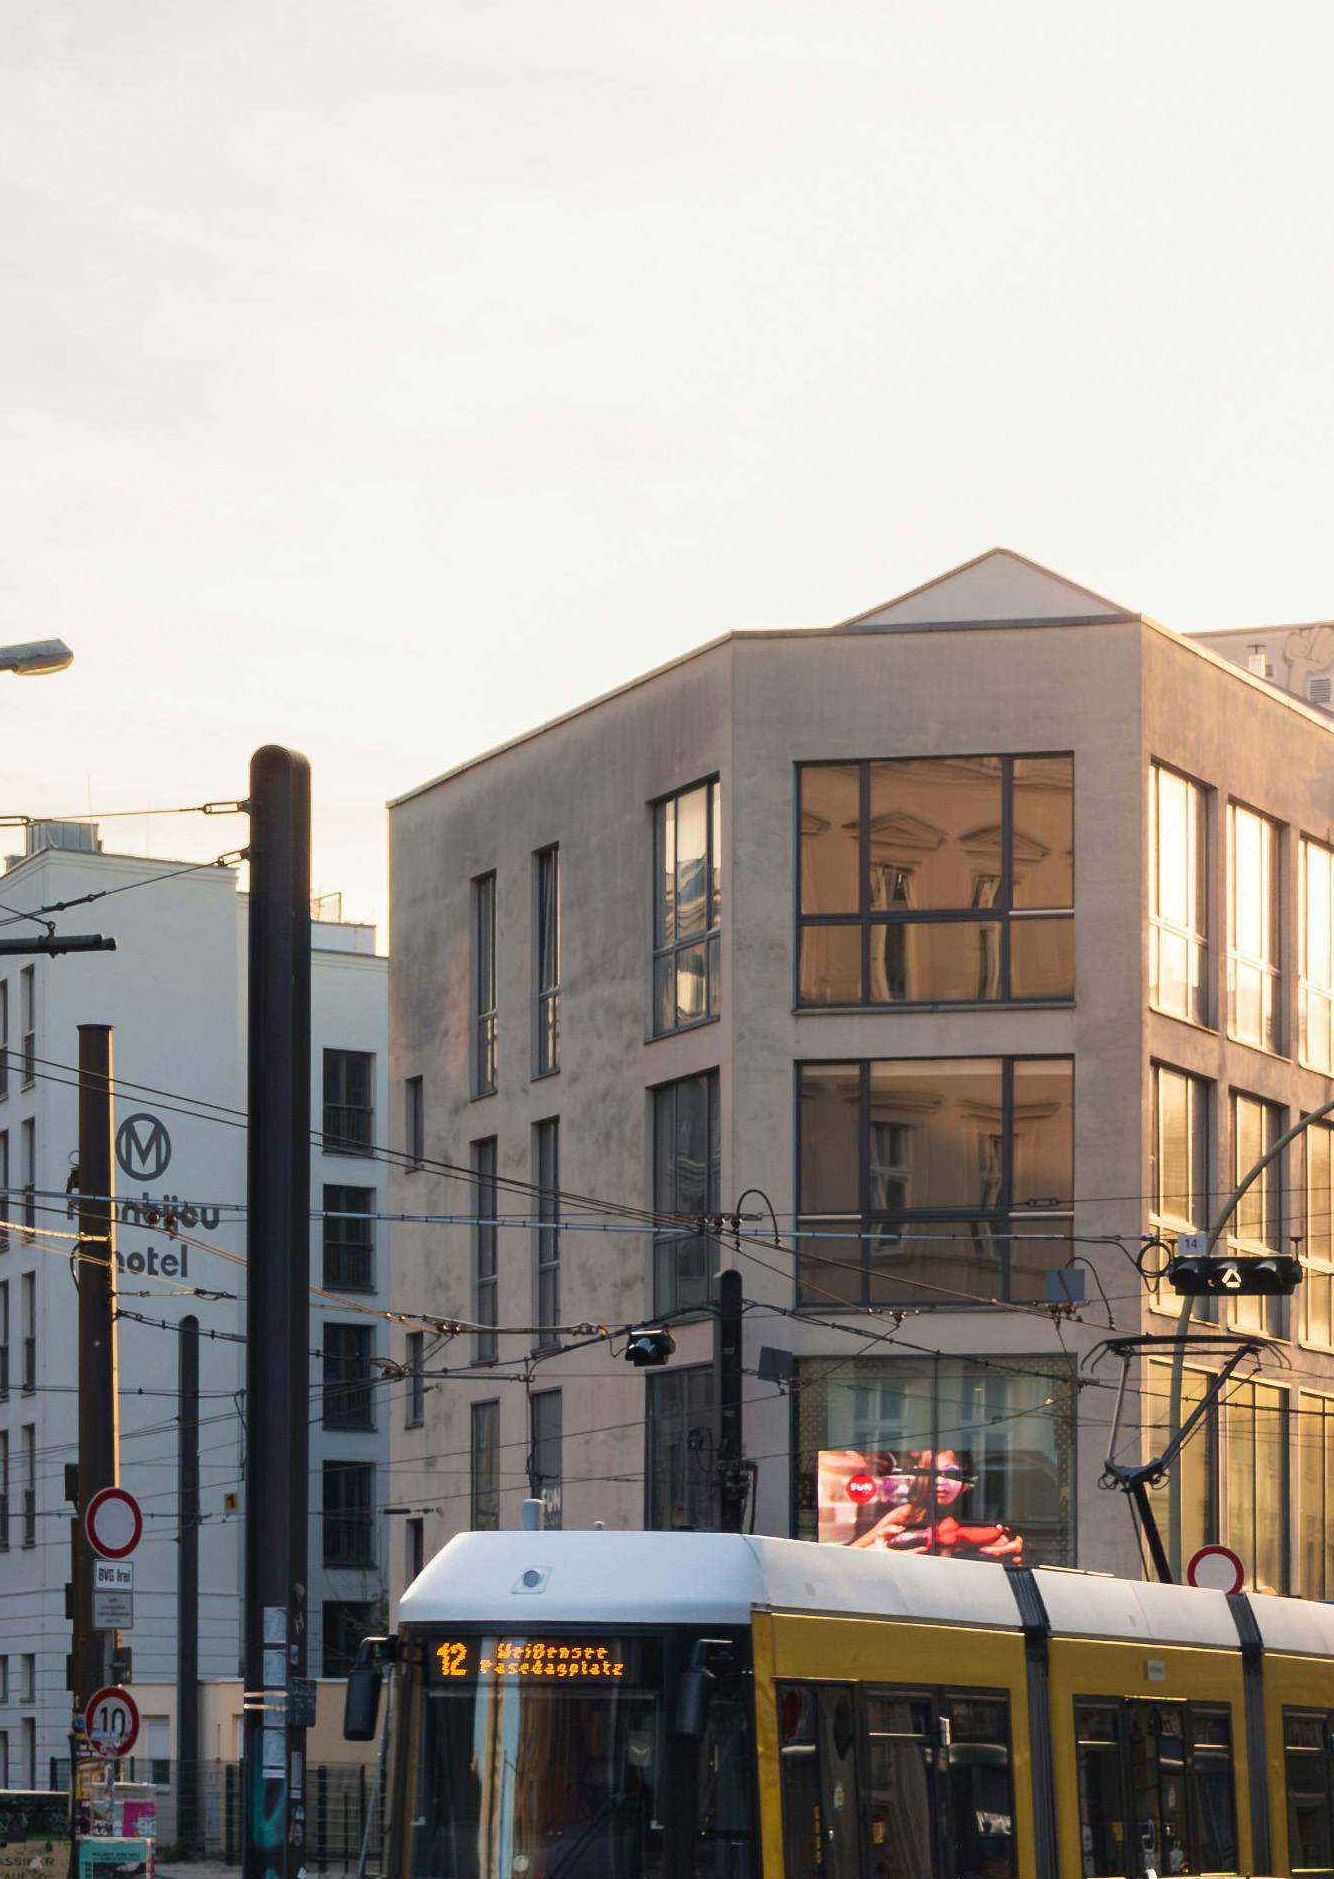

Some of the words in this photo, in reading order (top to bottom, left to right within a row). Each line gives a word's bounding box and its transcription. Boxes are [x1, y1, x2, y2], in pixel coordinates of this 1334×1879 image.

[1184, 1238, 1198, 1249] 14
[851, 1482, 873, 1492] FUN
[436, 1642, 468, 1676] 12
[100, 1707, 126, 1737] 10
